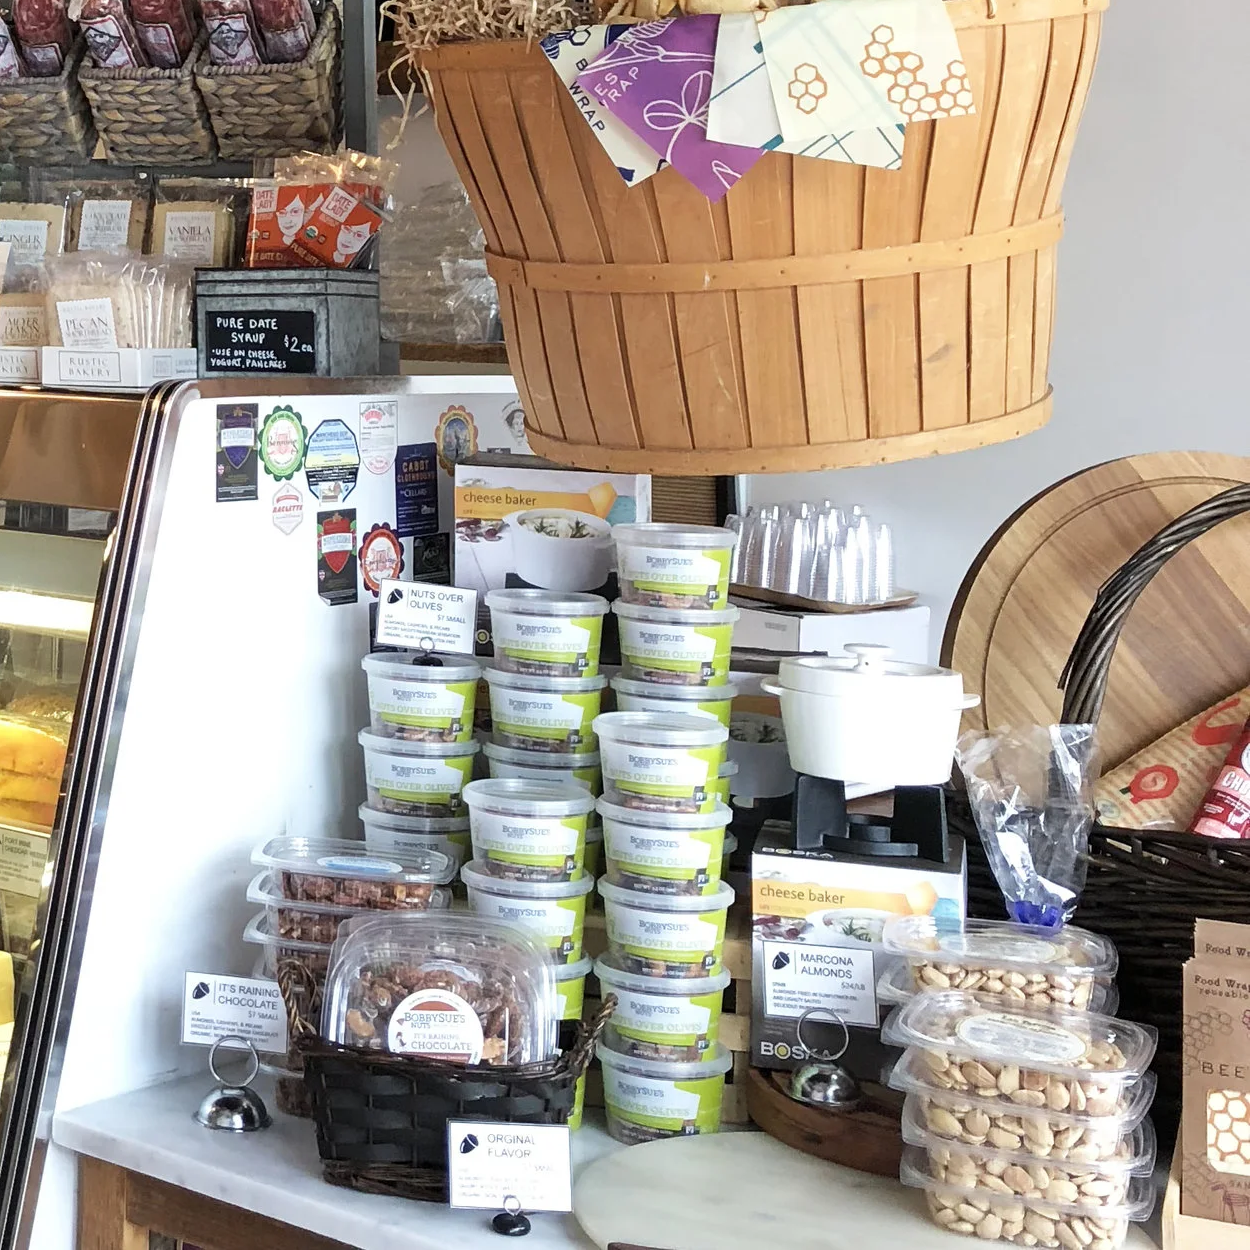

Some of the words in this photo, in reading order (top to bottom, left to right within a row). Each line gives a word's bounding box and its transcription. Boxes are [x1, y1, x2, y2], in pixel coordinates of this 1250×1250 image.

[569, 81, 606, 131] WRAP
[65, 316, 109, 330] PECAN
[216, 317, 244, 329] PURE
[249, 318, 279, 330] DATE
[231, 332, 266, 344] SYRUP
[284, 334, 300, 353] $2
[233, 349, 246, 357] ON
[69, 356, 109, 366] RUSTIC
[246, 358, 287, 370] PANCAKES
[68, 366, 113, 378] BAKERY
[402, 460, 429, 471] CABOT
[463, 491, 503, 505] cheese
[505, 492, 537, 507] baker
[410, 589, 436, 600] NUTS
[437, 592, 464, 603] OVER
[410, 600, 443, 611] OLIVES
[760, 884, 805, 901] cheese
[808, 889, 846, 905] baker
[800, 952, 854, 967] MARCONA
[801, 964, 853, 979] ALMONDS
[1194, 974, 1220, 987] Food
[218, 982, 236, 993] IT'S
[238, 985, 280, 999] RAINING
[218, 995, 279, 1011] CHOCOLATE
[410, 1040, 473, 1051] CHOCOLATE
[487, 1147, 533, 1159] FLAVOR
